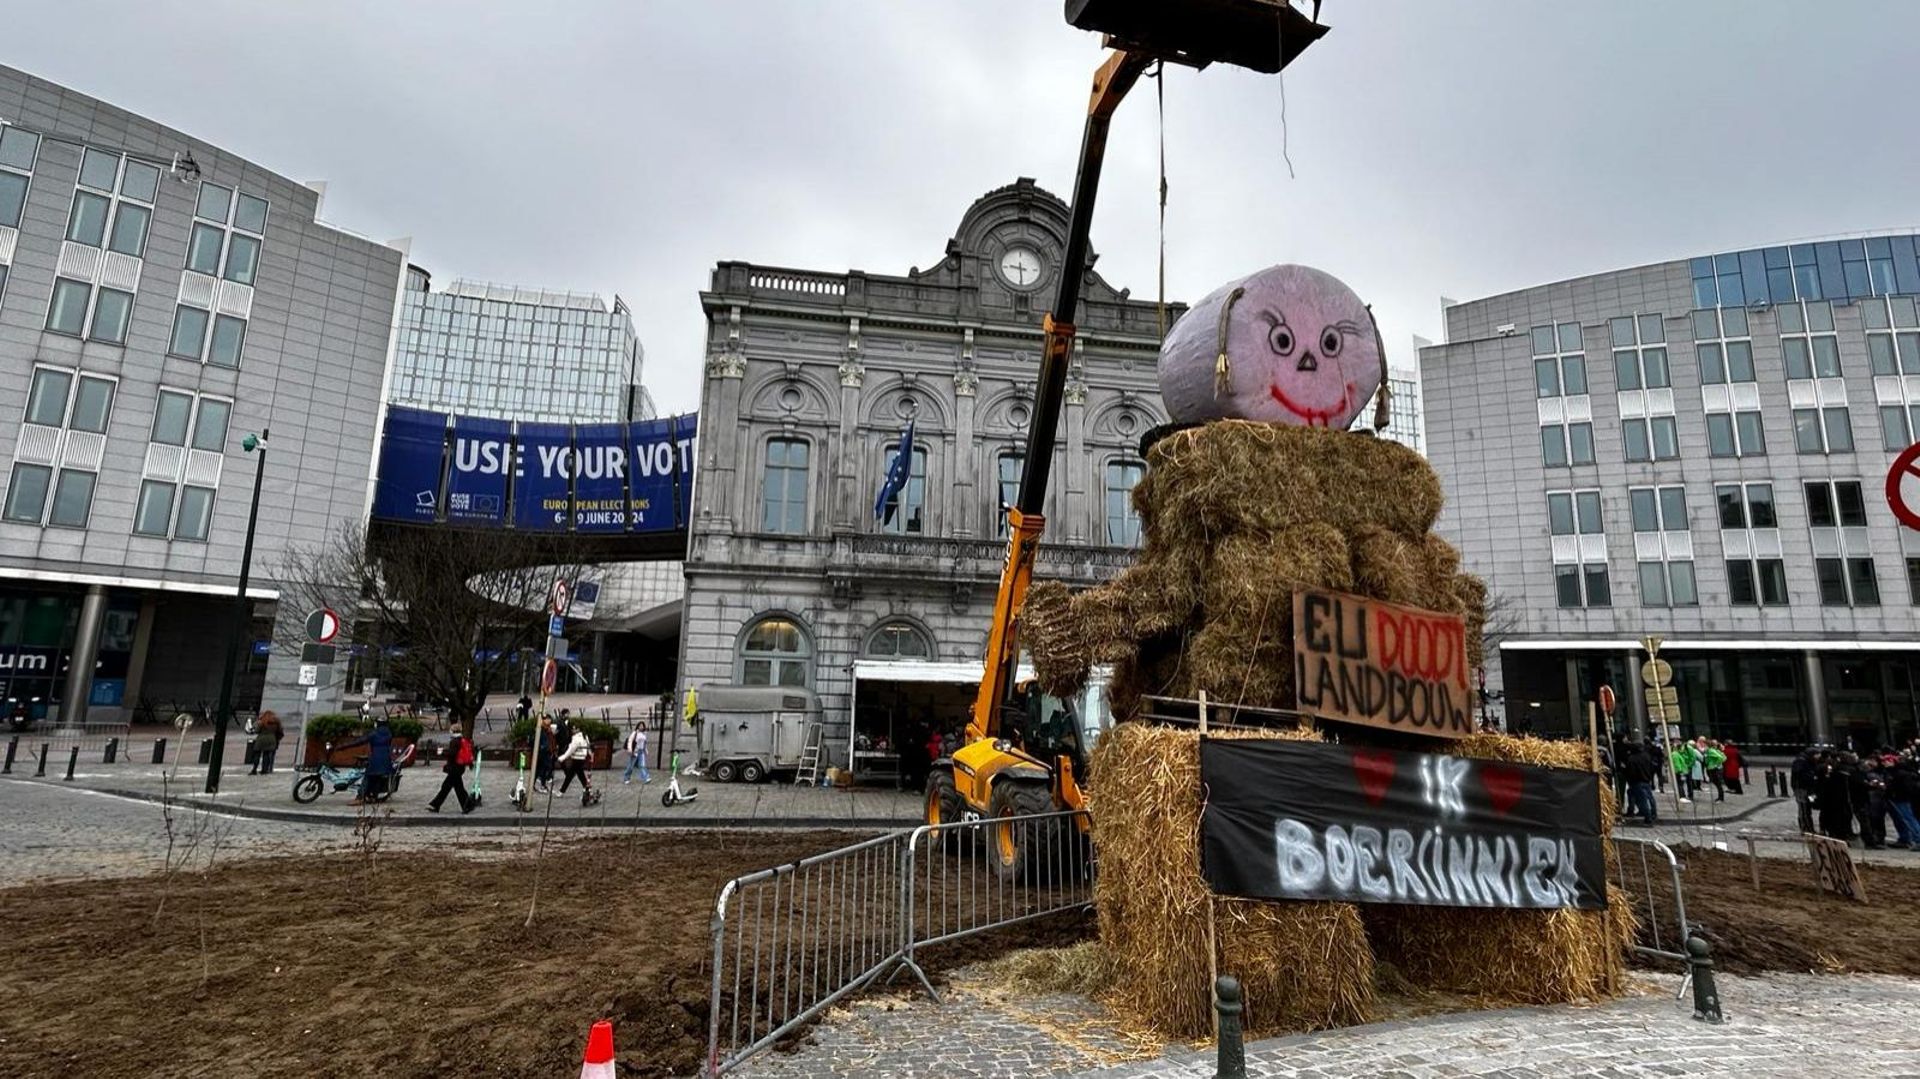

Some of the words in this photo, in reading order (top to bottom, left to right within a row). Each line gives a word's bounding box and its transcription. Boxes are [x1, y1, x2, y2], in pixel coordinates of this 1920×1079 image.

[455, 438, 525, 477] USE
[537, 444, 625, 480] YOUR
[585, 511, 611, 524] JUNE
[1304, 594, 1369, 660] EU
[1298, 652, 1473, 734] LANDBOUW
